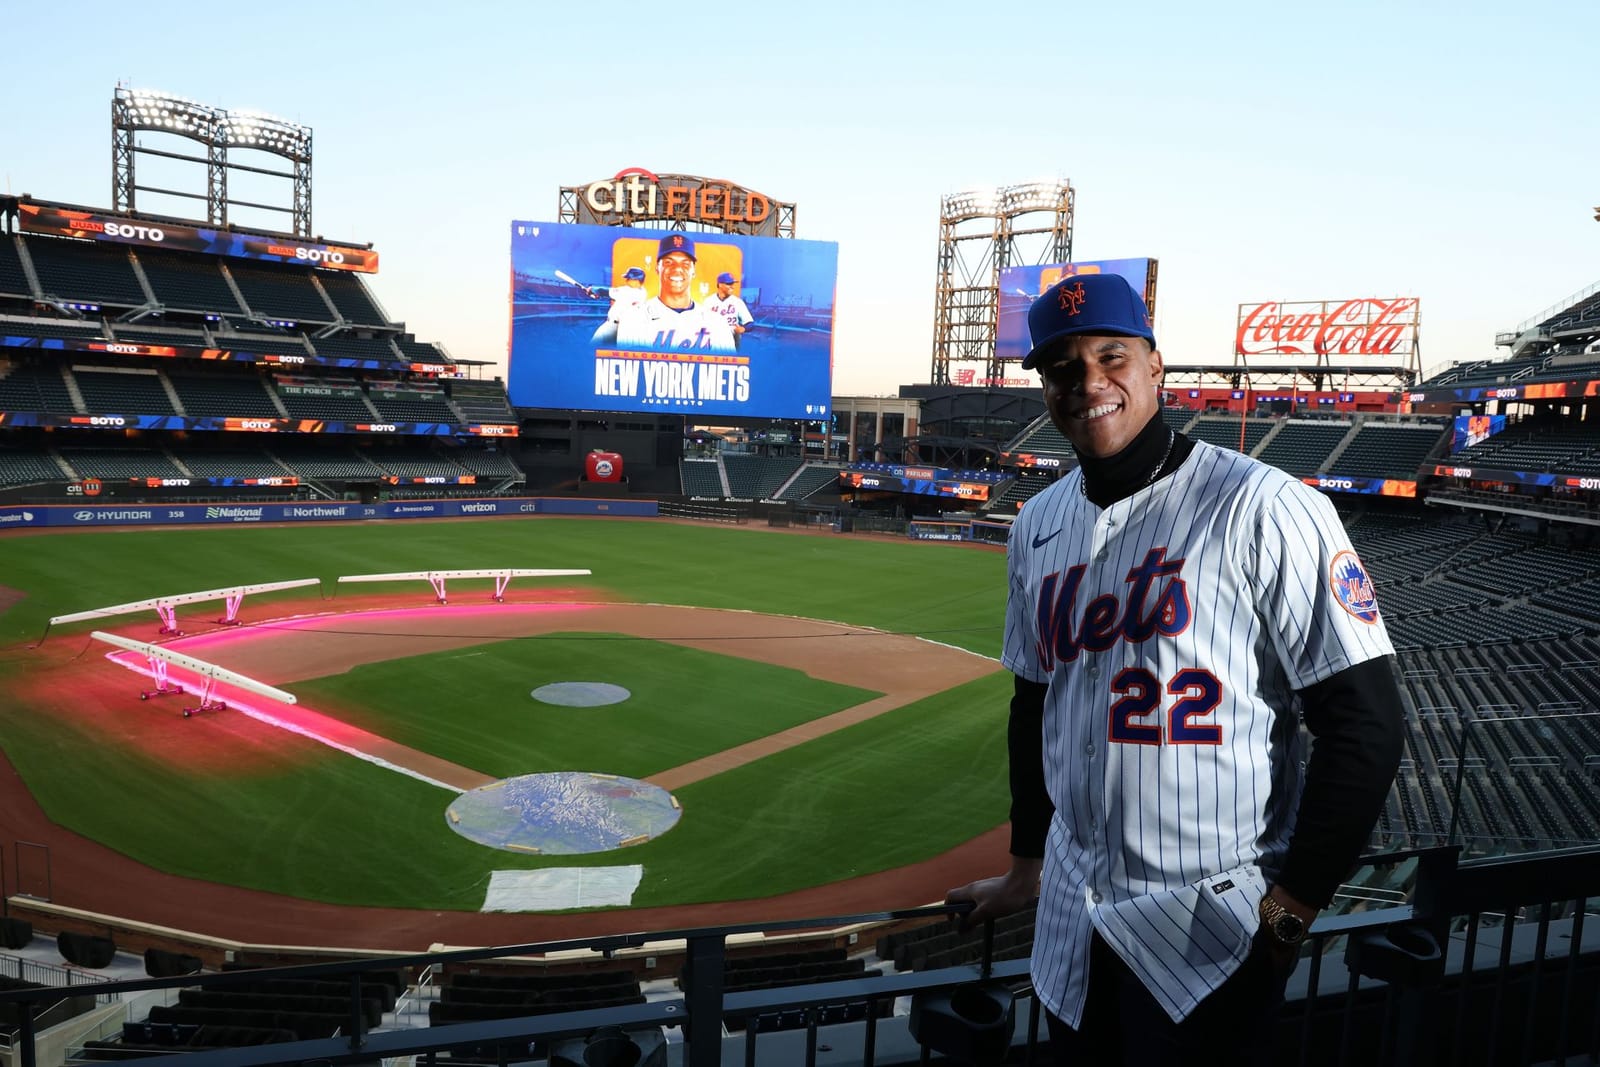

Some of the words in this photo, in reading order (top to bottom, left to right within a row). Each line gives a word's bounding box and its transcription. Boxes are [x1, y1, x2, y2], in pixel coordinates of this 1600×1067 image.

[667, 186, 770, 222] FIELD
[71, 220, 101, 231] JUAN
[104, 222, 164, 242] SOTO
[295, 248, 344, 264] SOTO
[106, 344, 138, 353] SOTO
[279, 356, 304, 364] SOTO
[612, 351, 678, 360] WELCOME
[422, 365, 444, 373] SOTO
[595, 358, 640, 397] NEW
[643, 360, 695, 399] YORK
[698, 363, 750, 402] METS
[303, 387, 331, 395] PORCH
[1496, 388, 1516, 398] SOTO
[1409, 393, 1424, 401] SOTO
[90, 417, 124, 426] SOTO
[241, 421, 271, 429] SOTO
[370, 424, 395, 432] SOTO
[481, 427, 504, 435] SOTO
[1036, 458, 1060, 467] SOTO
[906, 470, 932, 478] PAVILION
[1453, 468, 1471, 477] SOTO
[862, 478, 880, 486] SOTO
[1319, 479, 1352, 489] SOTO
[1579, 478, 1600, 489] SOT
[952, 487, 973, 495] SOTO
[461, 503, 496, 512] verizon
[520, 502, 535, 512] citi
[97, 511, 151, 520] HYUNDAI
[168, 510, 184, 518] 358
[218, 507, 263, 517] National
[293, 507, 345, 517] Northwell
[363, 508, 375, 516] 370
[1035, 547, 1192, 673] Mets
[1108, 667, 1223, 746] 22
